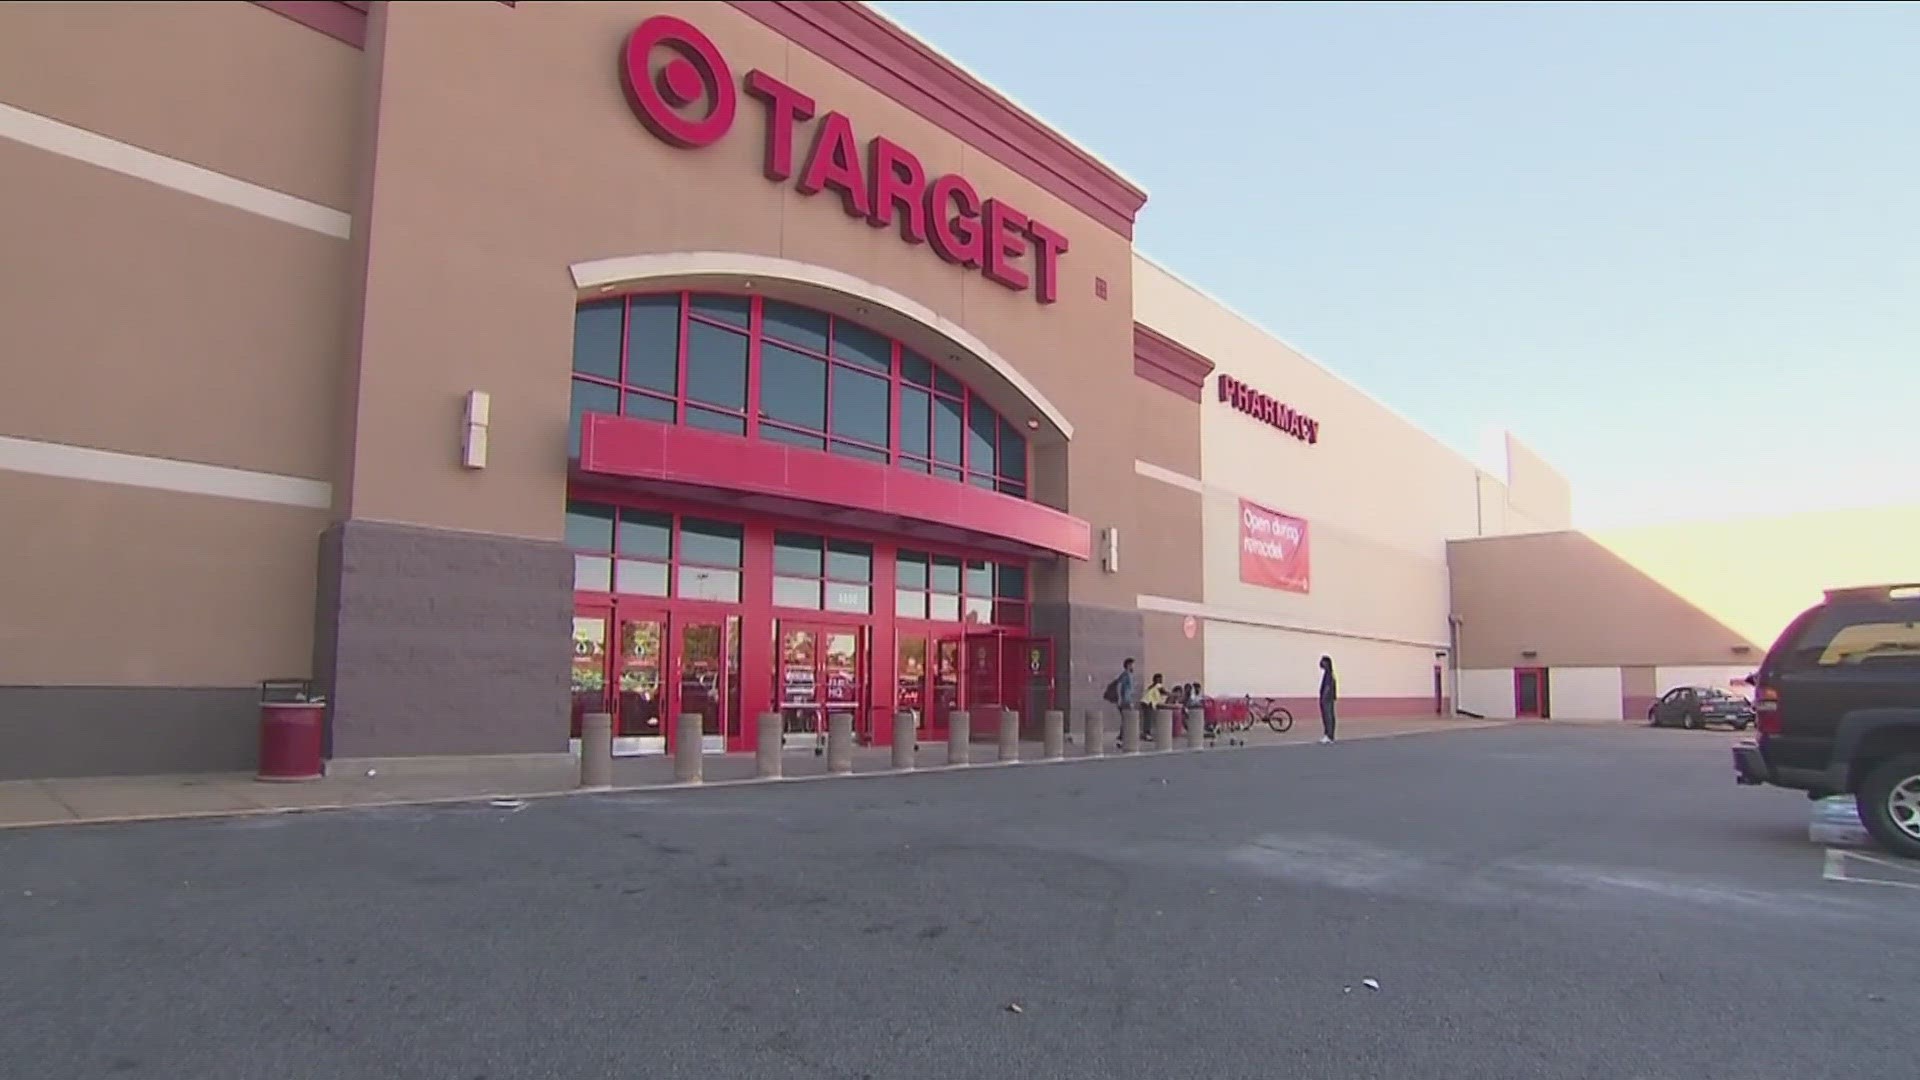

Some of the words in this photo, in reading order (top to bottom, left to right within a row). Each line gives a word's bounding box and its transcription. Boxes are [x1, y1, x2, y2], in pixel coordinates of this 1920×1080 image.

[744, 68, 1069, 304] TARGET
[1218, 373, 1319, 444] PHARMACY
[1243, 508, 1270, 533] Open
[1271, 516, 1300, 545] during
[1243, 536, 1283, 560] remodel
